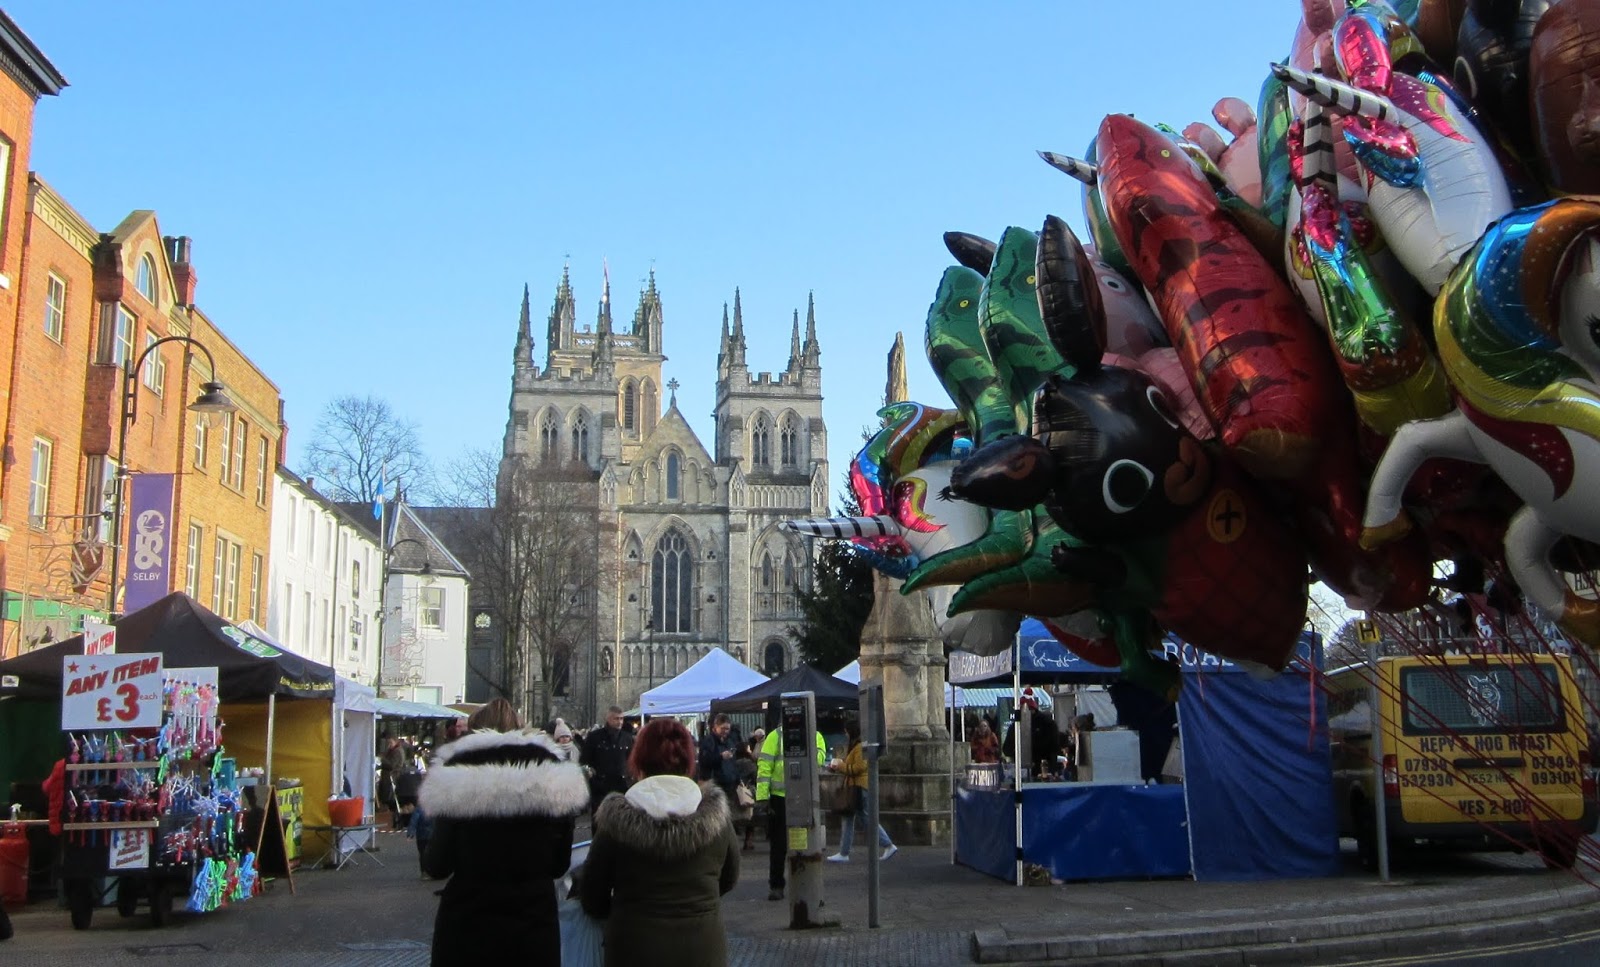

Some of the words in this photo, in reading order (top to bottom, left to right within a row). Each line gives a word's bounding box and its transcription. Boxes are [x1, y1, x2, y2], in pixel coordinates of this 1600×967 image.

[133, 572, 160, 581] SELBY
[99, 630, 115, 650] ITEM
[1359, 620, 1376, 640] H
[1161, 642, 1234, 667] ROA
[65, 670, 109, 696] ANY
[112, 656, 160, 684] ITEM
[96, 682, 140, 722] £3
[139, 692, 158, 701] each
[1474, 735, 1503, 751] HOG
[1509, 733, 1553, 751] ROAST
[1490, 799, 1498, 815] 2
